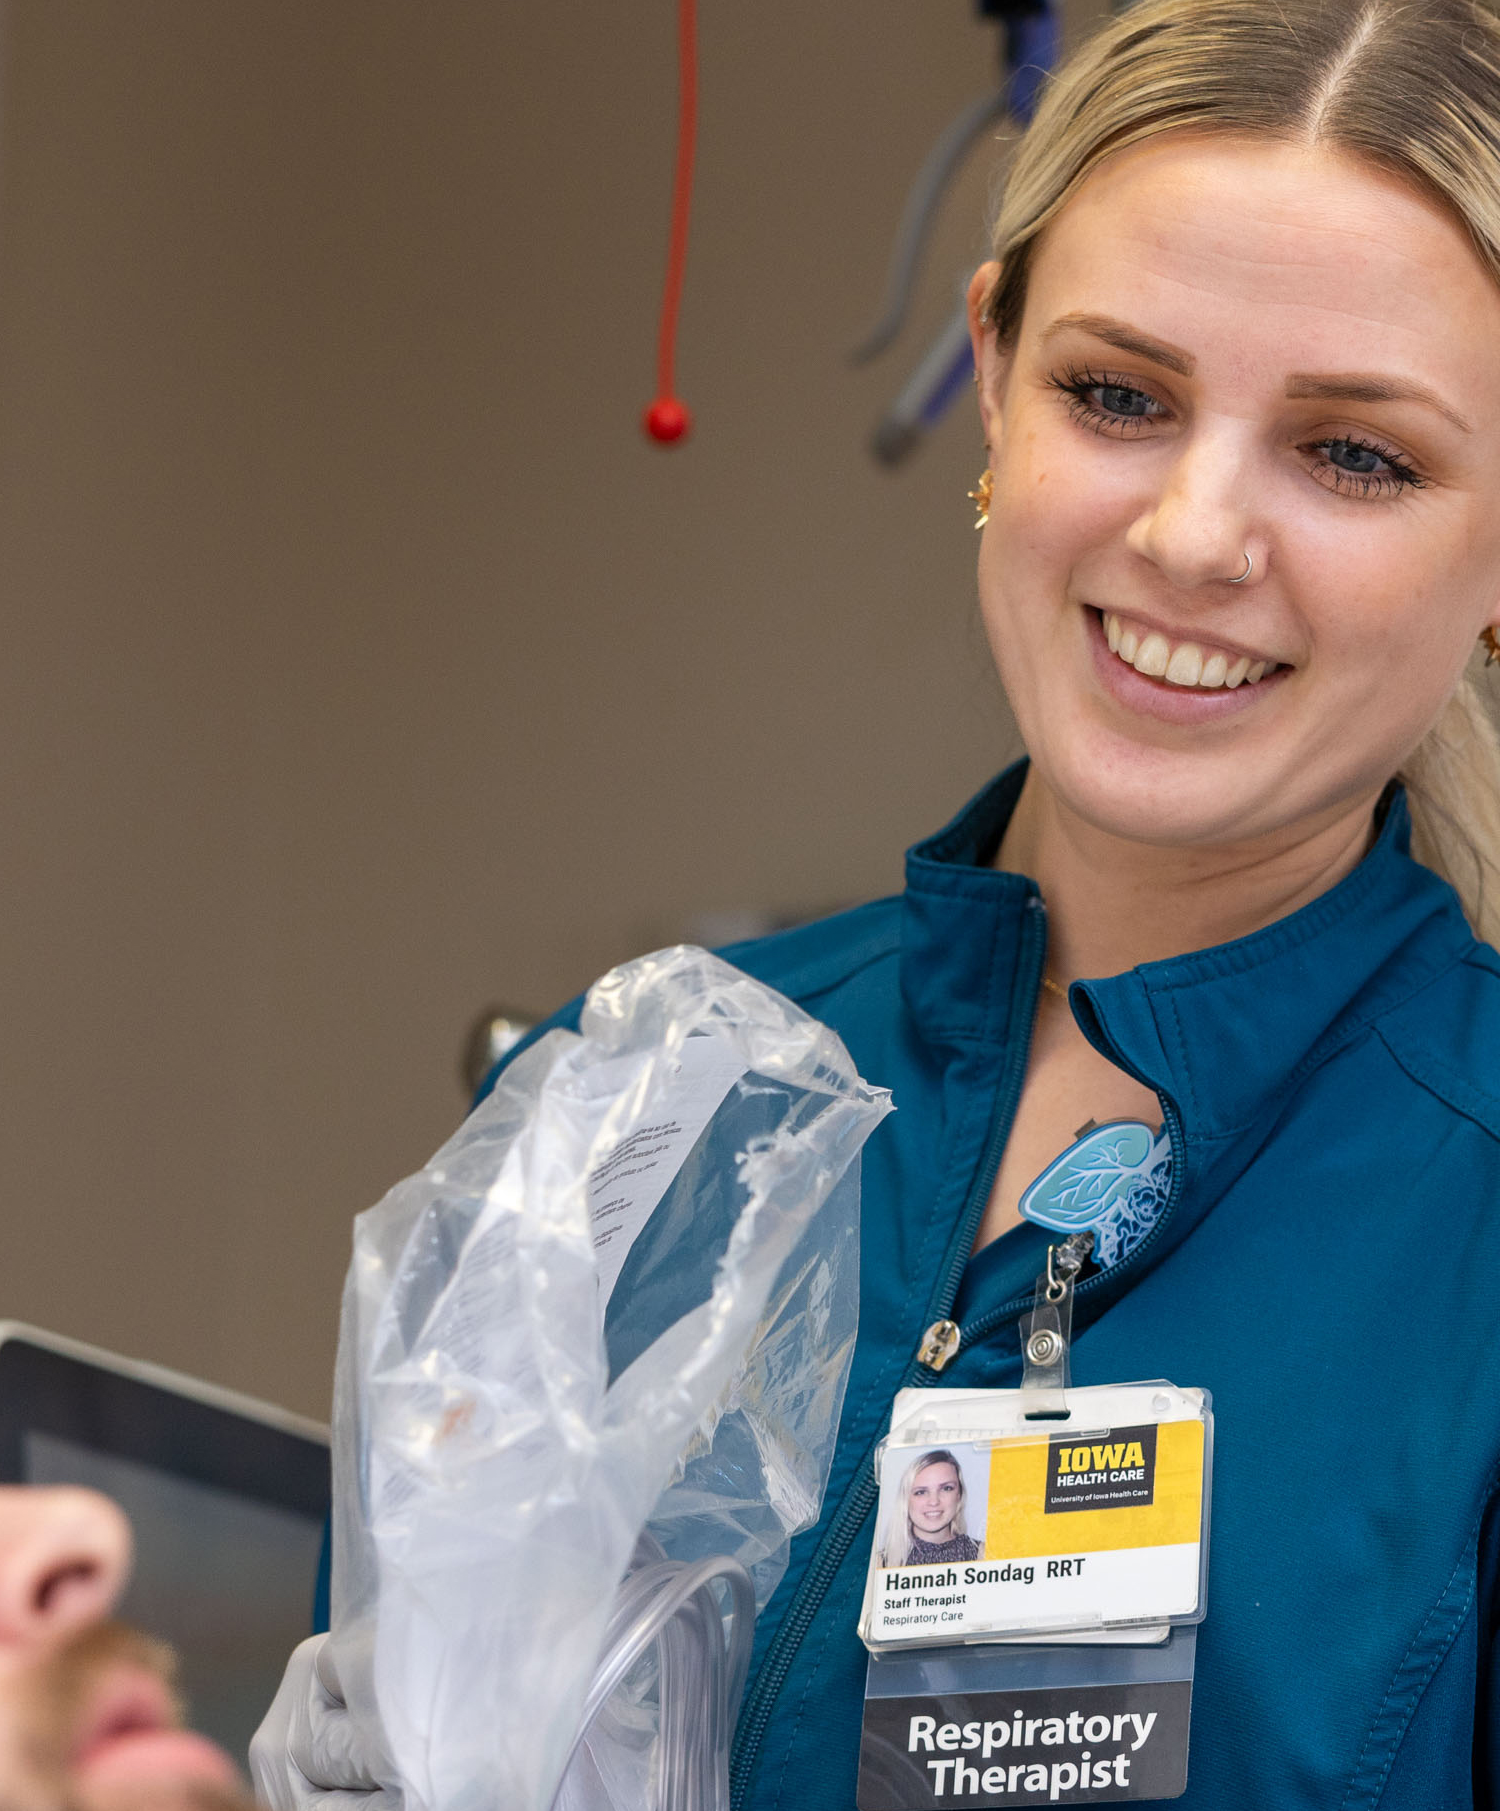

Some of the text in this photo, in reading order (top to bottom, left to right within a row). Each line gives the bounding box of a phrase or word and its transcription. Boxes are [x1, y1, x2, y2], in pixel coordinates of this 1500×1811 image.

[1057, 1442, 1145, 1474] IOWA
[1056, 1468, 1145, 1488] HEALTH CARE
[1050, 1489, 1149, 1504] University of Iowa Health Care
[886, 1558, 1086, 1591] Hannah Sondag RRT
[884, 1594, 967, 1610] Staff Therapist
[883, 1611, 964, 1627] Respiratory Care
[908, 1709, 1158, 1759] Respiratory
[927, 1751, 1131, 1801] Therapist
